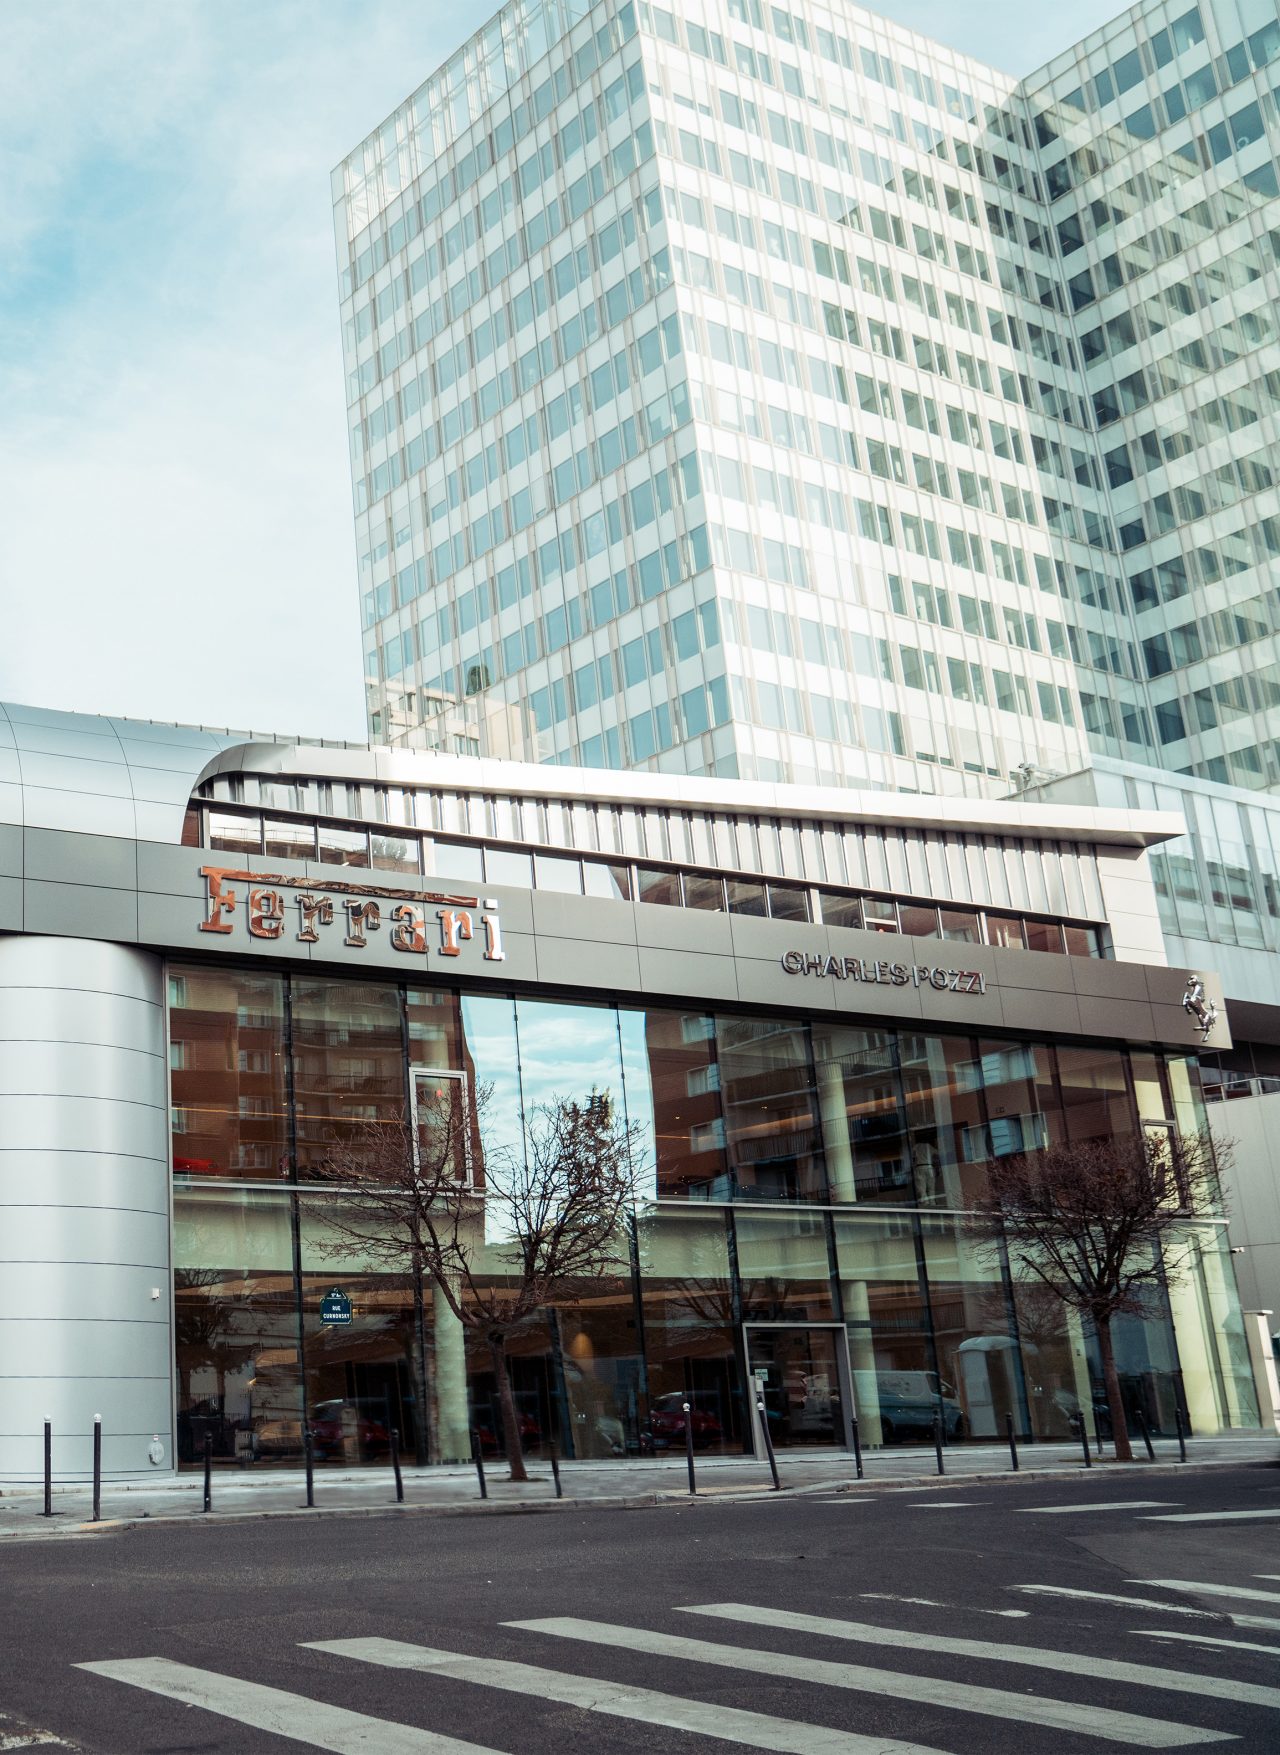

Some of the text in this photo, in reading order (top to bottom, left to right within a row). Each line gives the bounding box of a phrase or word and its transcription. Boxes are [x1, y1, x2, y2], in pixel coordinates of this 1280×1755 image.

[200, 866, 506, 961] Ferrari
[782, 951, 987, 995] CHARLES POZZI
